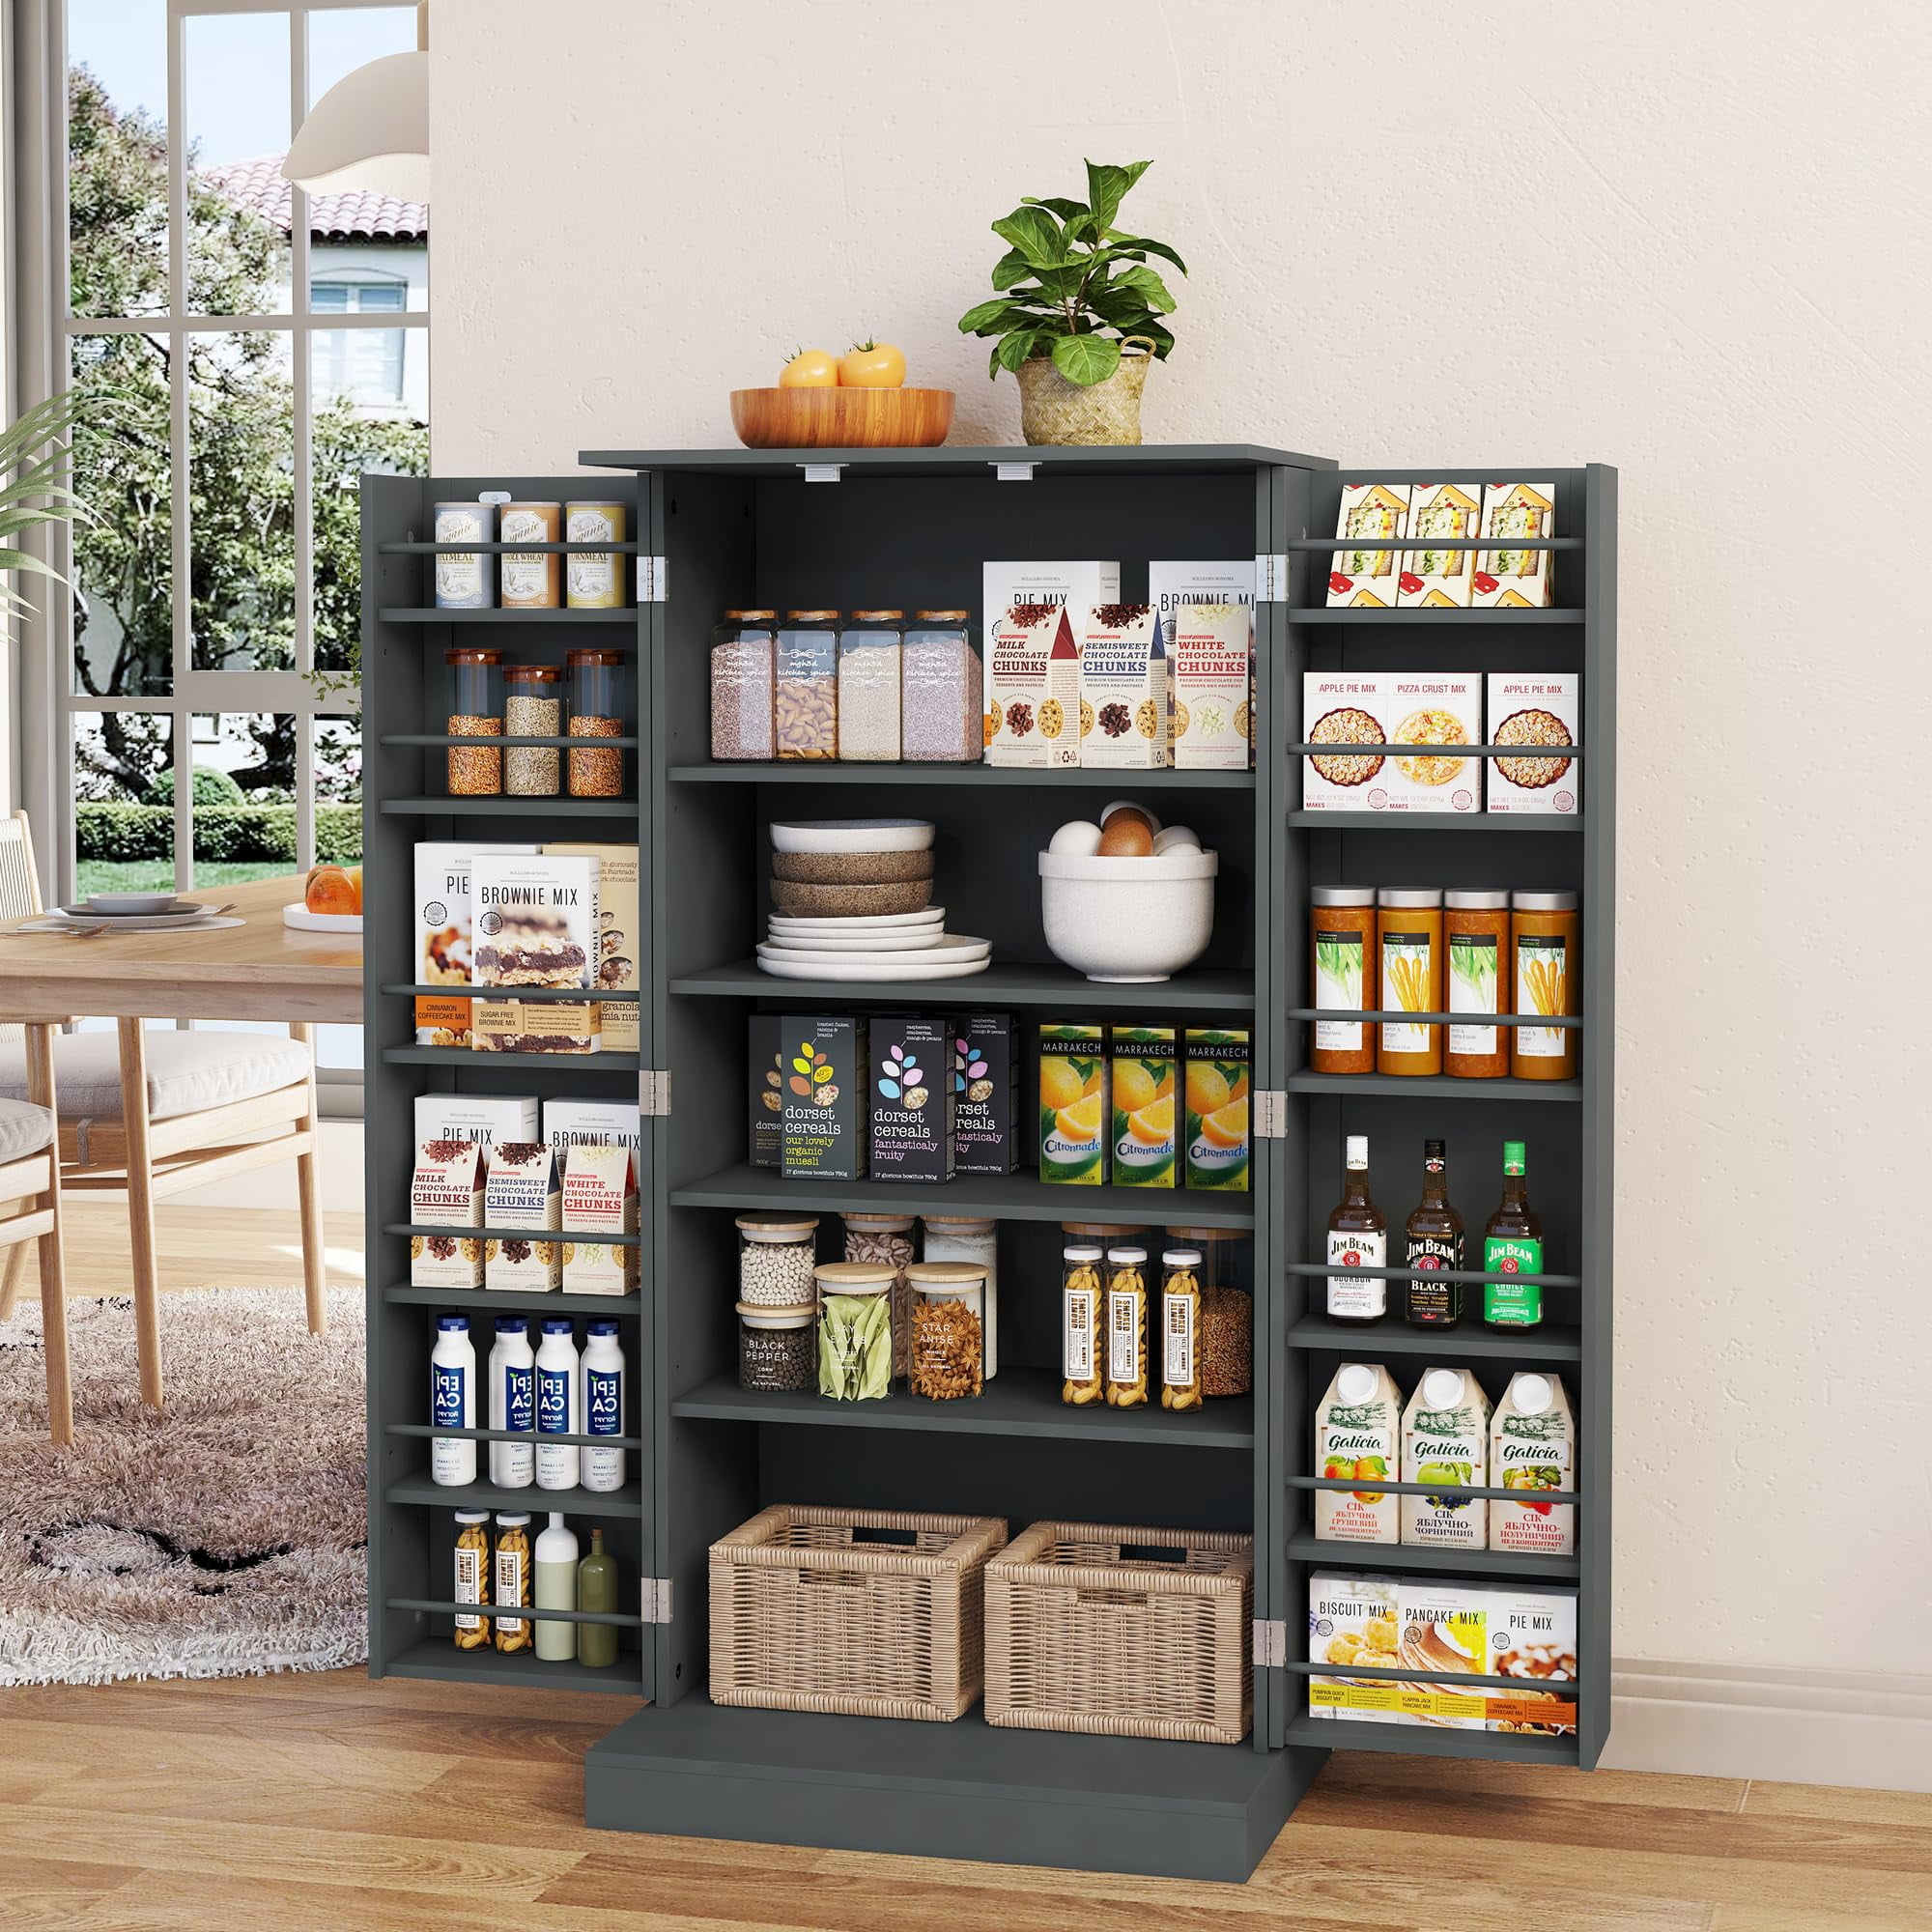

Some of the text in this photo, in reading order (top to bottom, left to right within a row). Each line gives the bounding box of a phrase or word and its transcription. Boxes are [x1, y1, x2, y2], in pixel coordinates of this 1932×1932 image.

[993, 661, 1047, 671] CHUNKS
[1083, 661, 1147, 671] CHUNKS
[1178, 662, 1245, 672] CHUNKS
[1320, 684, 1377, 694] APPLE PIE MIX
[1397, 685, 1466, 694] PIZZA CRUST MIX
[1504, 685, 1562, 694] APPLE PIE MIX
[446, 875, 469, 895] PIE
[481, 887, 578, 906] BROWNIE MIX
[603, 1003, 639, 1011] granola
[1043, 1042, 1101, 1053] MARRAKECH
[1115, 1044, 1174, 1055] MARRAKECH
[1188, 1046, 1248, 1057] MARRAKECH
[785, 1105, 836, 1120] dorset
[956, 1103, 989, 1115] rset
[874, 1109, 924, 1122] dorset
[755, 1121, 781, 1130] dorse
[785, 1122, 841, 1135] cereals
[956, 1117, 995, 1130] reals
[874, 1124, 931, 1138] cereals
[470, 1128, 493, 1146] MIX
[553, 1131, 639, 1151] BROWNIE MIX
[806, 1136, 834, 1148] lovely
[1045, 1139, 1100, 1152] Citronnade
[1118, 1142, 1174, 1155] Citronnade
[1190, 1144, 1247, 1158] Citronnade
[785, 1147, 823, 1156] organic
[875, 1151, 904, 1161] fruity
[786, 1157, 819, 1166] muesli
[488, 1186, 545, 1195] CHOCOLATE
[413, 1193, 469, 1203] CHUNKS
[487, 1196, 545, 1207] CHUNKS
[564, 1199, 621, 1209] CHUNKS
[1331, 1237, 1374, 1256] JIM BEAM
[1406, 1238, 1455, 1262] JIM BEAM
[1489, 1243, 1532, 1264] JIM BEAM
[1411, 1280, 1447, 1292] BLACK
[922, 1323, 951, 1332] STAR
[749, 1341, 784, 1350] BLACK
[920, 1335, 953, 1345] ANISE
[746, 1351, 789, 1361] PEPPER
[1328, 1435, 1383, 1451] Galicia
[1415, 1441, 1473, 1457] Galicia
[1503, 1444, 1563, 1461] Galicia
[1347, 1502, 1364, 1511] СІК
[1335, 1511, 1377, 1520] ЯБЛУЧНО-
[1435, 1510, 1453, 1519] СІК
[1523, 1514, 1542, 1522] СІК
[1416, 1519, 1471, 1529] ЯБЛУЧНО-
[1505, 1522, 1561, 1532] ЯБЛУЧНО-
[1415, 1527, 1474, 1538] ЧОРНИЧНИЙ
[1320, 1602, 1387, 1618] BISCUIT MIX
[1406, 1608, 1479, 1625] PANCAKE MIX
[1510, 1615, 1551, 1631] PIE MIX
